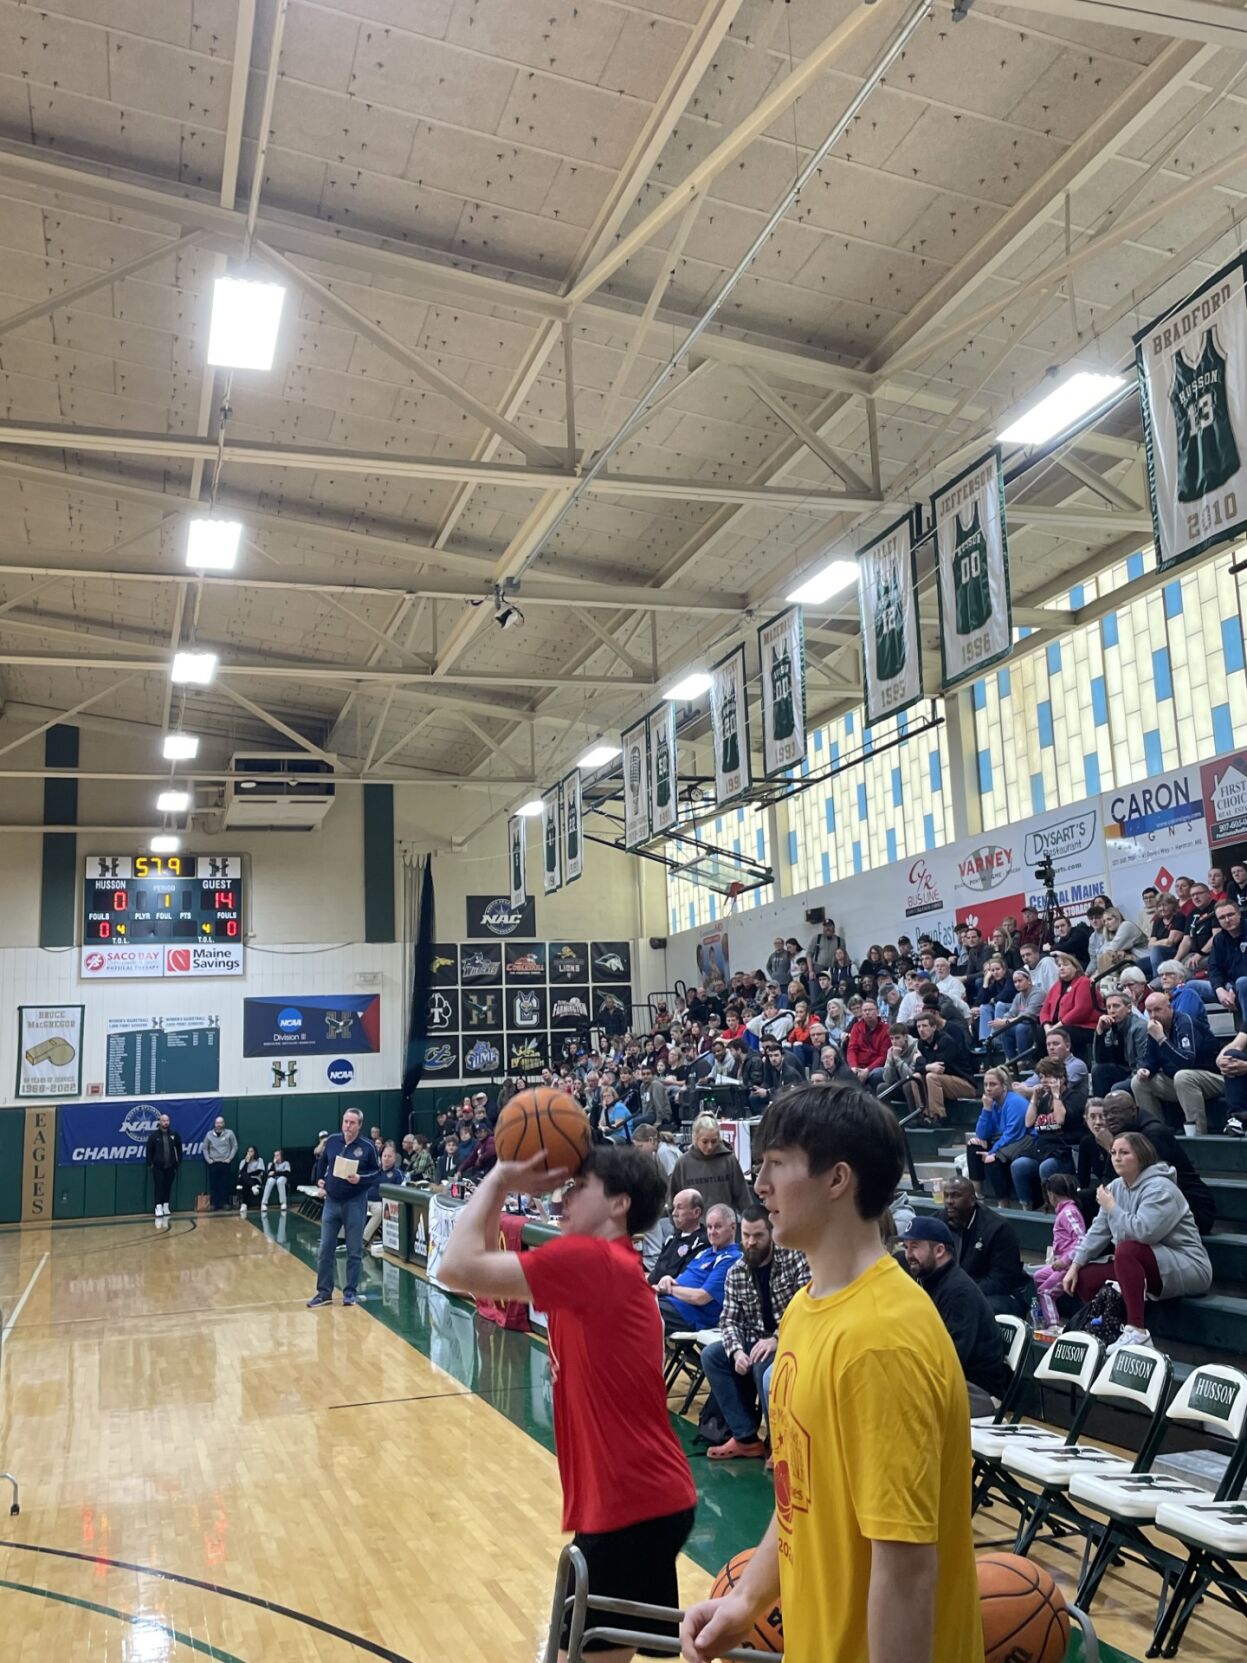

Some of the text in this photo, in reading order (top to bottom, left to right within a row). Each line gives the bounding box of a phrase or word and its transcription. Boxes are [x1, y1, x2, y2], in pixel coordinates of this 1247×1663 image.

[1152, 283, 1231, 356] BRADFORD
[1178, 369, 1218, 409] HUSSON
[1186, 393, 1216, 437] 13
[940, 465, 994, 517] JEFFERSON
[1187, 492, 1238, 540] 2010
[961, 551, 981, 585] 00
[1221, 780, 1247, 797] FIRST
[1111, 777, 1190, 823] CARON
[1033, 822, 1086, 855] DYSART'S
[1043, 840, 1082, 857] Restaurant
[958, 848, 1012, 878] VARNEY
[95, 880, 127, 889] HUSSON
[202, 879, 232, 889] GUEST
[114, 891, 128, 911] 0
[164, 894, 171, 908] 1
[215, 892, 235, 909] 14
[908, 888, 940, 908] BUS LINE
[1029, 882, 1105, 909] CENAL MAINE
[89, 912, 110, 920] FOULS
[135, 912, 151, 920] PLYR
[156, 912, 172, 920] FOUL
[217, 911, 237, 919] FOULS
[480, 914, 522, 925] NAC
[99, 922, 110, 938] 0
[116, 923, 127, 935] 4
[202, 922, 213, 934] 4
[227, 920, 237, 937] 0
[107, 952, 136, 960] SACO
[193, 949, 232, 959] Maine
[193, 958, 240, 970] Savings
[39, 1011, 66, 1019] BRUCE
[280, 1019, 302, 1027] NCAA
[273, 1033, 300, 1041] Division
[330, 1070, 354, 1080] NCAA
[32, 1112, 47, 1215] EAGLES
[687, 1174, 731, 1186] ESSENTIALS
[1054, 1344, 1086, 1364] HUSSON
[1116, 1354, 1153, 1380] HUSSON
[1195, 1378, 1236, 1406] HUSSON
